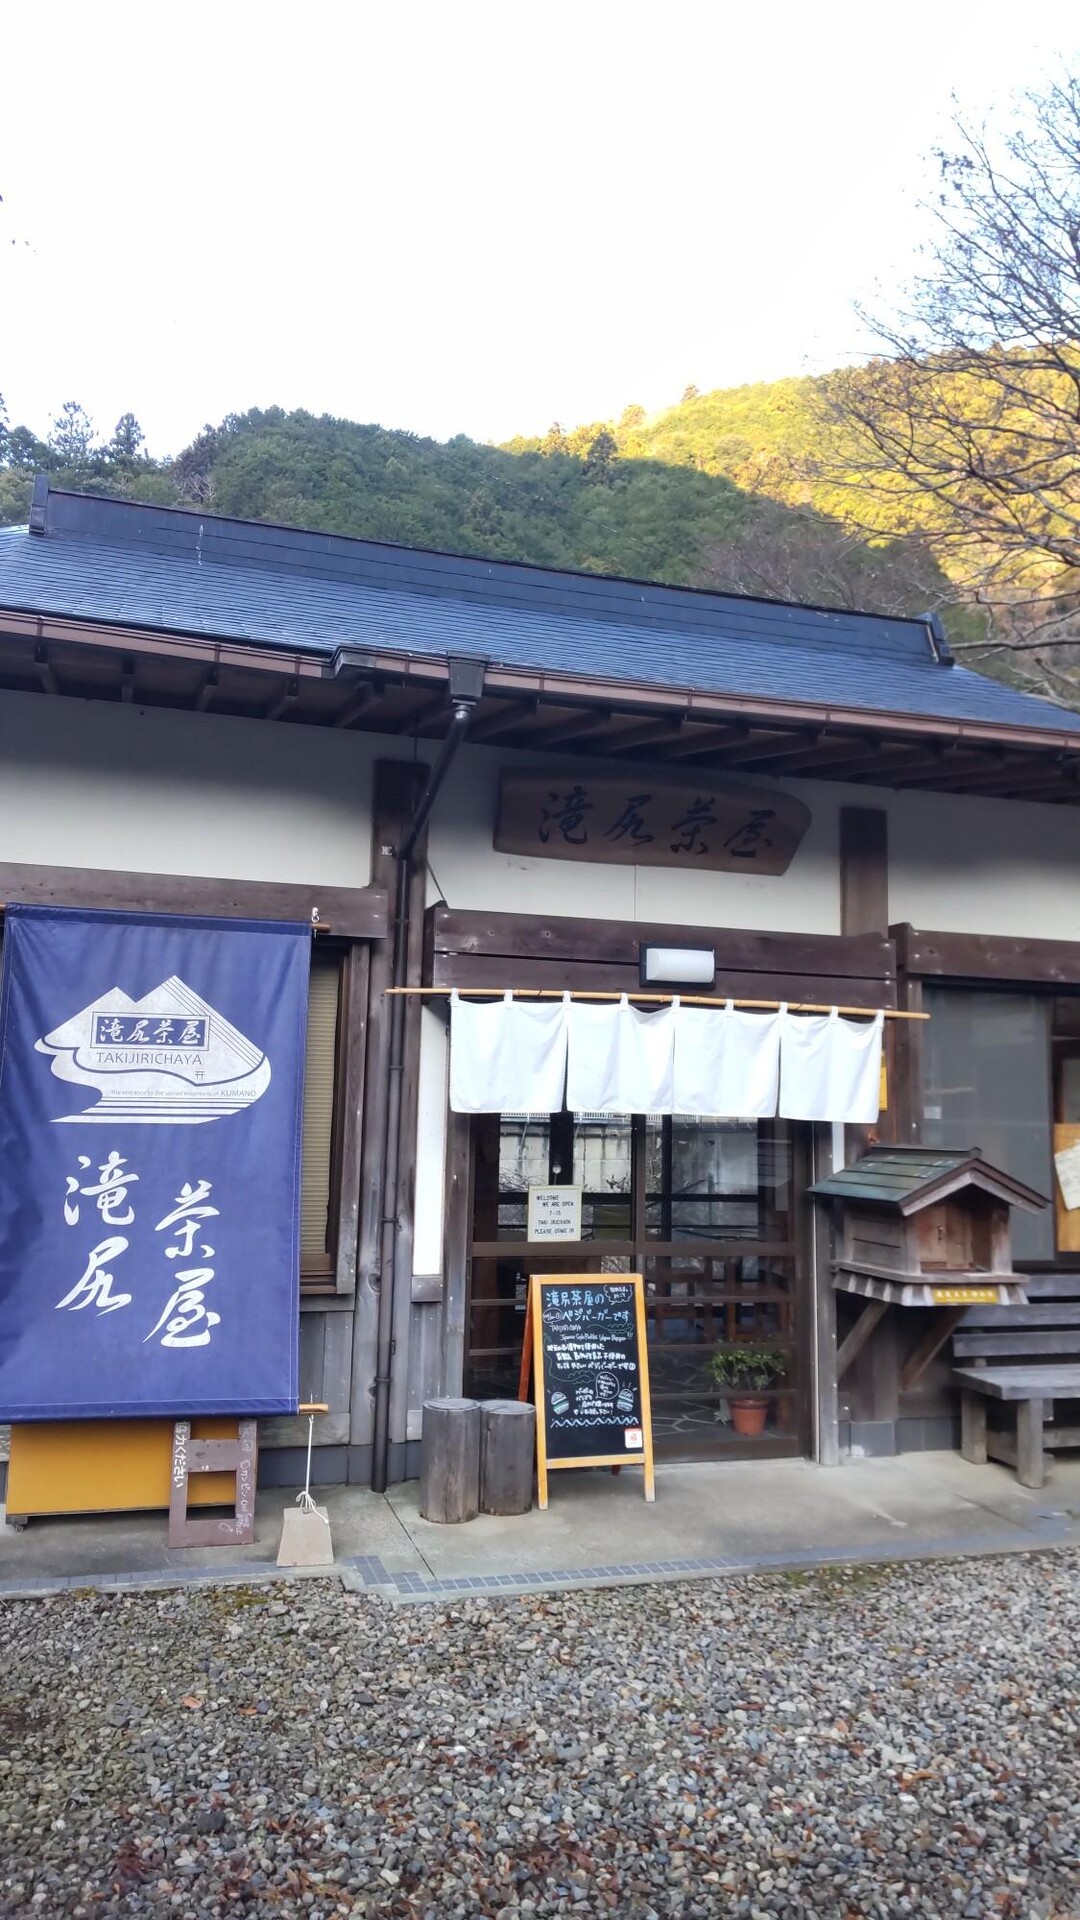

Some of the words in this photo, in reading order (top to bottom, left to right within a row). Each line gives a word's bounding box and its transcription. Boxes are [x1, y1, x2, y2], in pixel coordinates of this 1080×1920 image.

[538, 786, 776, 859] 滝尻茶屋
[100, 1018, 202, 1045] 滝尻茶屋
[96, 1052, 202, 1065] TAKIJIRICHAYA
[220, 1089, 257, 1097] KUMANO
